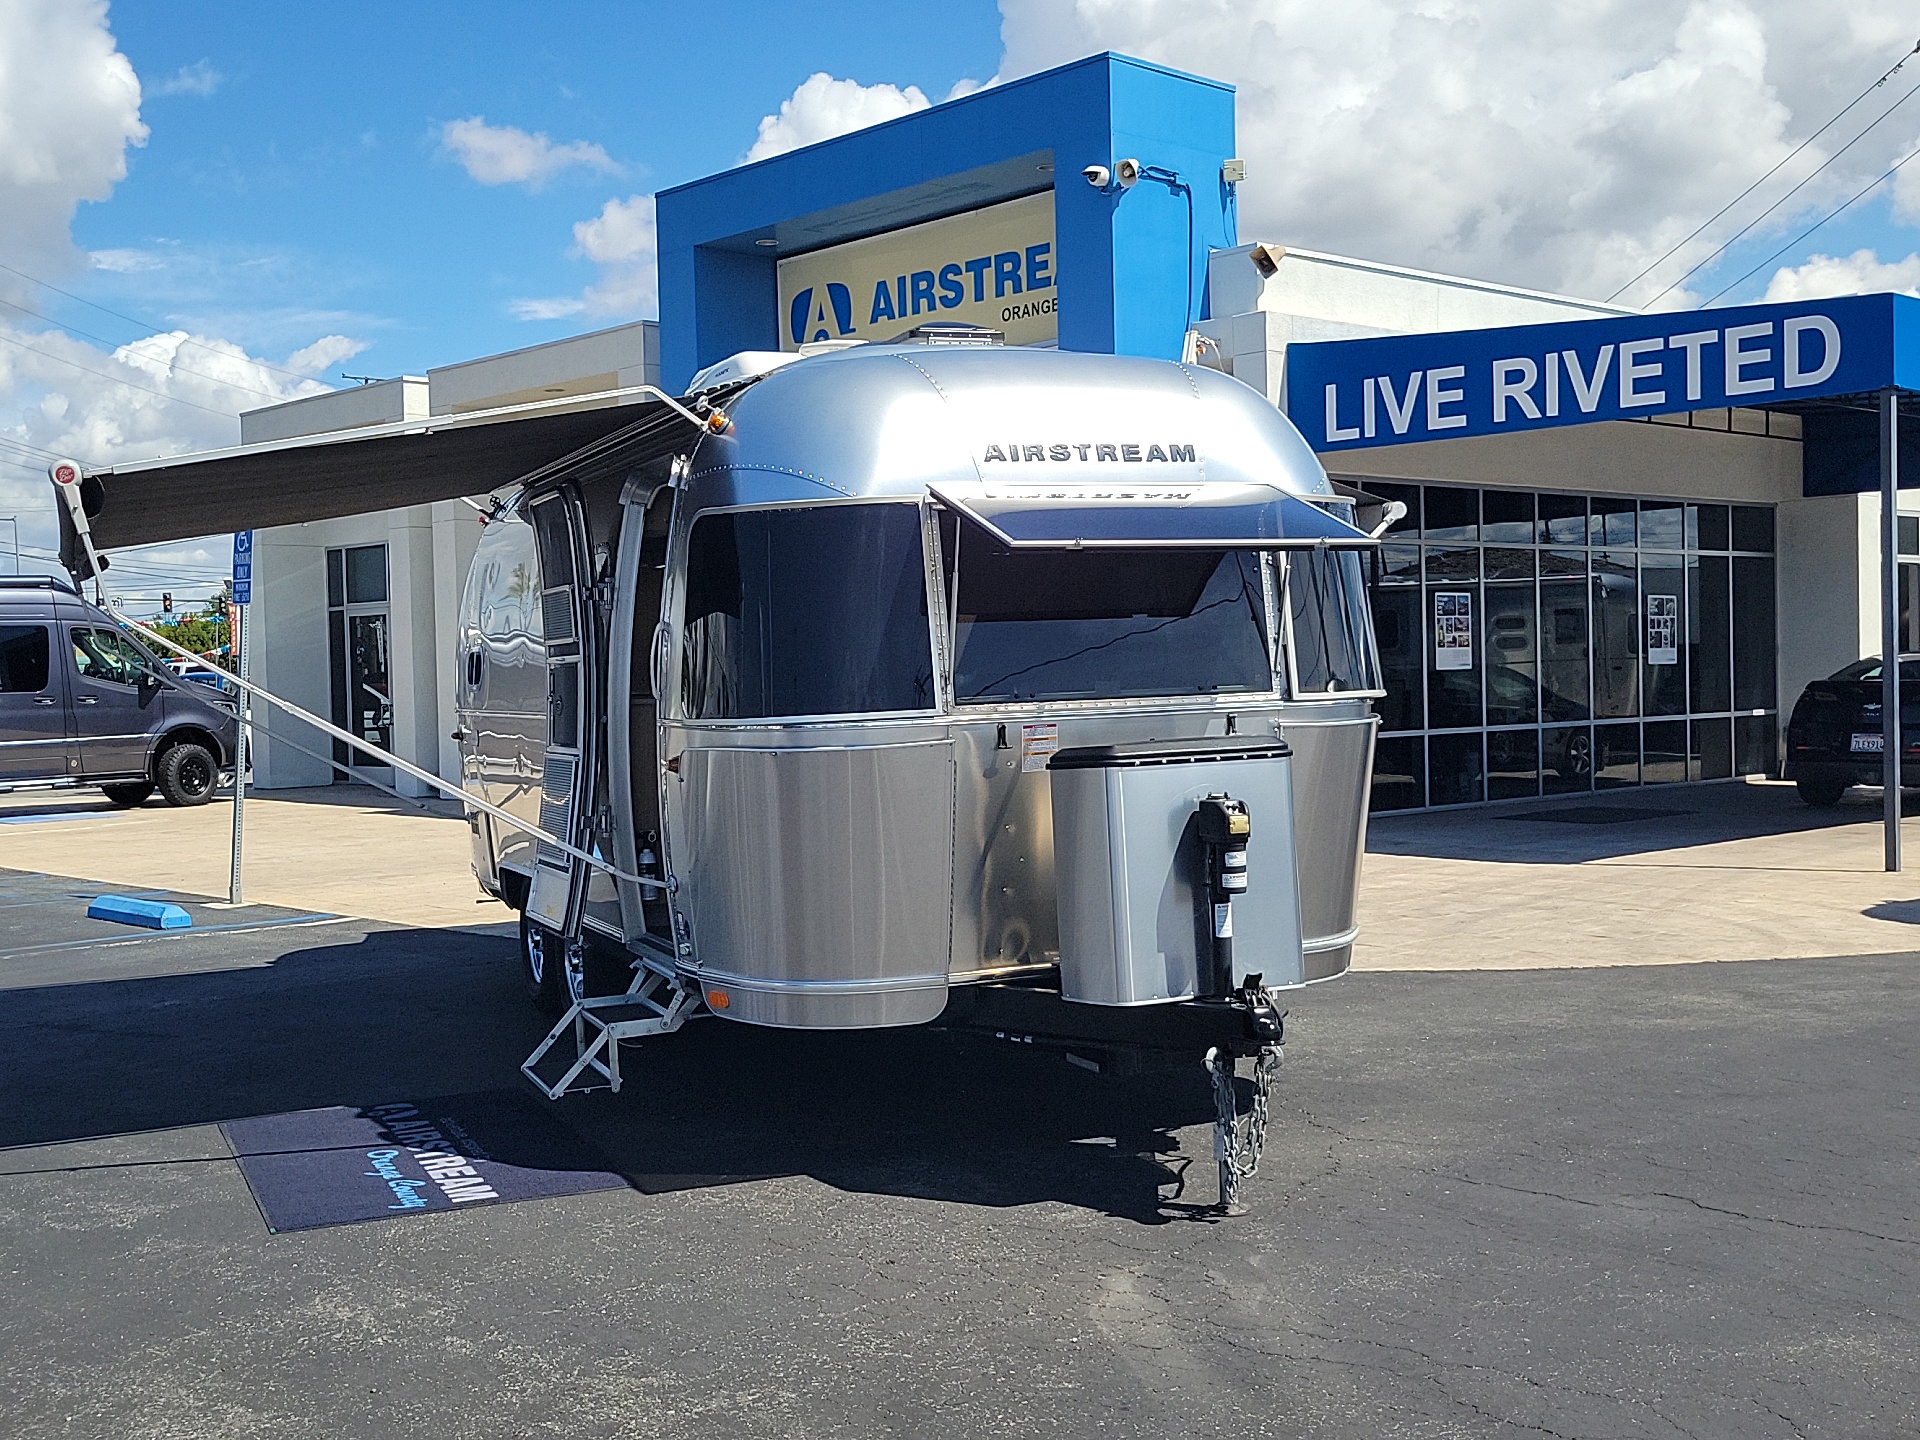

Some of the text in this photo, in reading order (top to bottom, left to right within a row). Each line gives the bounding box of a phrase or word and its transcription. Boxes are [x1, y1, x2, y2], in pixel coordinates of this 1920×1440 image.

[869, 242, 1058, 324] AIRSTRE
[1001, 298, 1058, 322] ORANGE
[1325, 314, 1842, 442] LIVE RIVETED
[984, 443, 1196, 463] AIRSTREAM
[234, 552, 252, 565] PARKING
[236, 566, 248, 578] ONLY
[363, 1150, 404, 1180] Orange
[387, 1120, 499, 1203] AIRSTREAM
